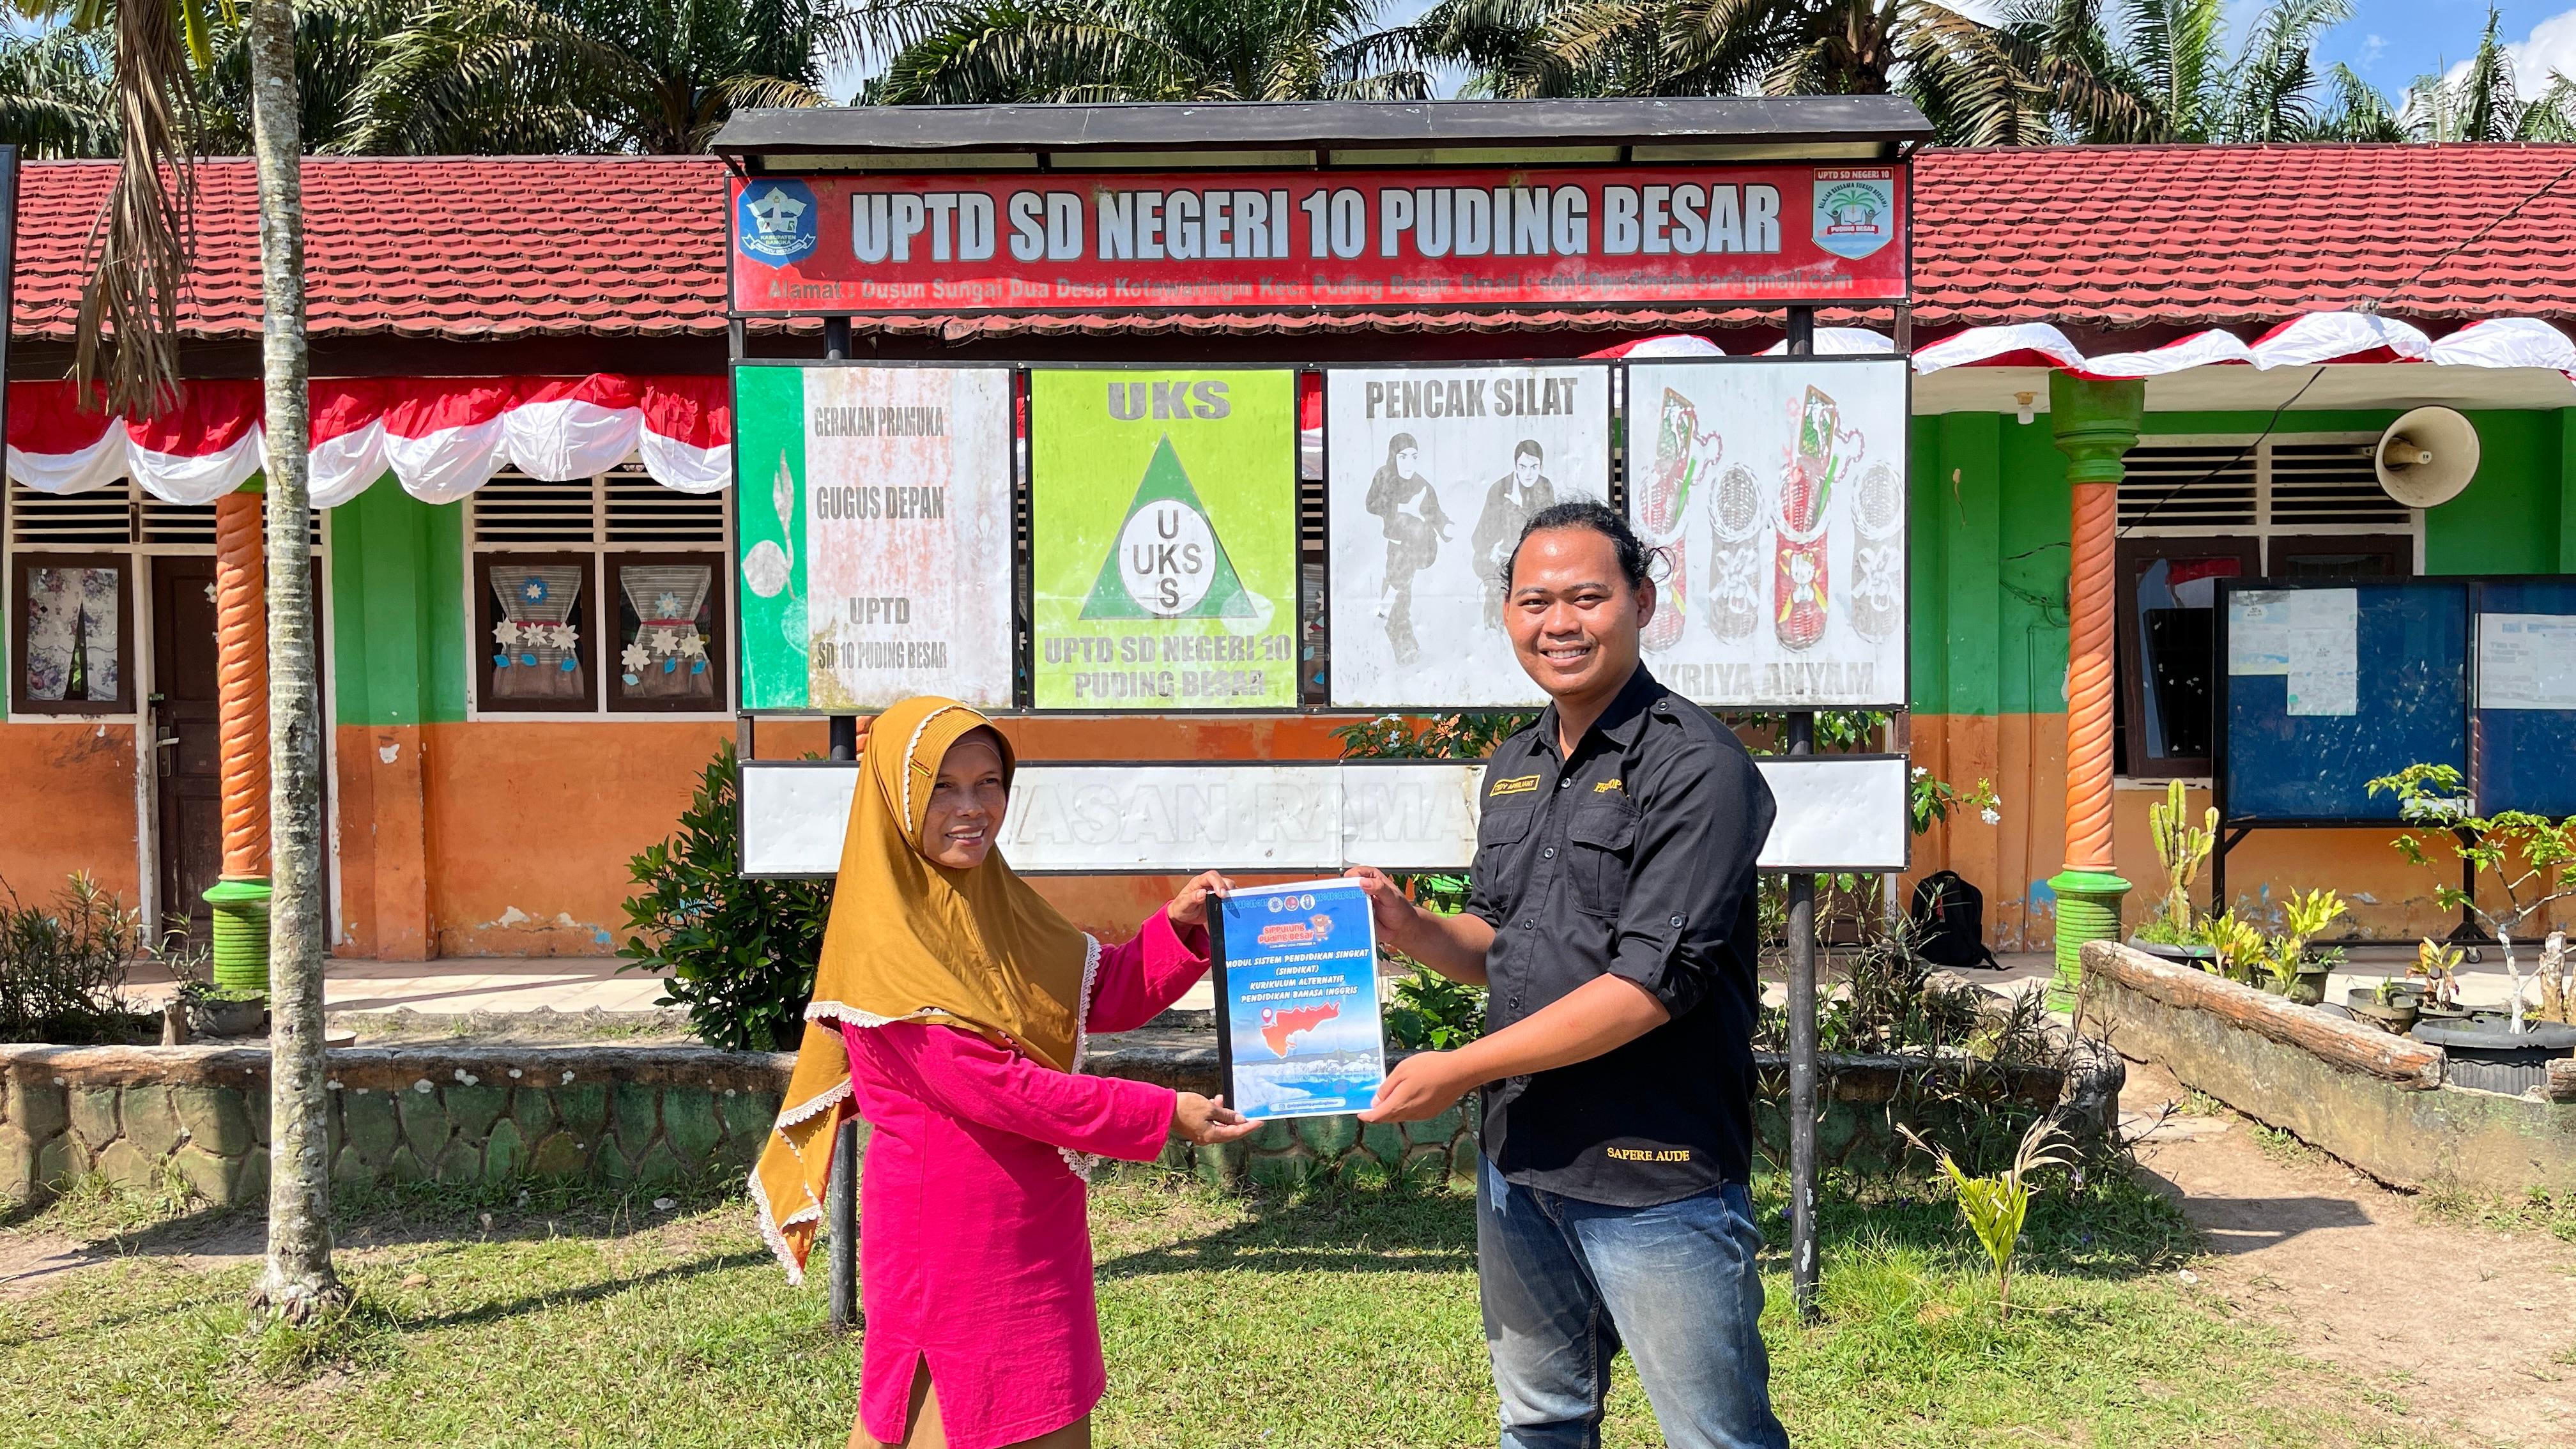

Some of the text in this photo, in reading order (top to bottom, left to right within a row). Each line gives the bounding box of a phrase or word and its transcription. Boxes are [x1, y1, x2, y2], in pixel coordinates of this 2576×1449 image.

[852, 183, 1782, 263] UPTD SD NEGERI 10 PUDING BESAR
[768, 279, 841, 299] Alamat
[862, 279, 925, 299] Dusun
[933, 277, 1003, 302] Sungai
[1010, 277, 1048, 298] Dua
[1056, 277, 1108, 298] Desa
[1114, 275, 1253, 300] Kotawaringin
[1260, 275, 1306, 296] Kec.
[1313, 275, 1384, 299] Puding
[1462, 273, 1519, 294] Email
[1108, 381, 1231, 421] UKS
[1366, 378, 1578, 419] PENCAK SILAT
[815, 407, 944, 437] GERAKAN PRAMUKA
[816, 486, 944, 520] GUGUS DEPAN
[1133, 544, 1203, 574] UKS
[849, 597, 910, 624] UPTD
[818, 641, 947, 669] SD 10 PUDING BESAR
[1045, 634, 1291, 664] UPTD SD NEGERI 10
[1075, 670, 1265, 698] PUDING BESAR
[1659, 662, 1874, 696] KRIYA ANYAM
[1225, 949, 1370, 969] MODUL SISTEM PENDIDIKAN SINGKAT
[1275, 964, 1320, 976] (SINDIKAT)
[1240, 985, 1358, 1004] PENDIDIKAN BAHASA INGGRIS
[1249, 974, 1346, 990] KURIKULUM ALTERNATIF
[1607, 1147, 1690, 1162] SAPERE AUDE
